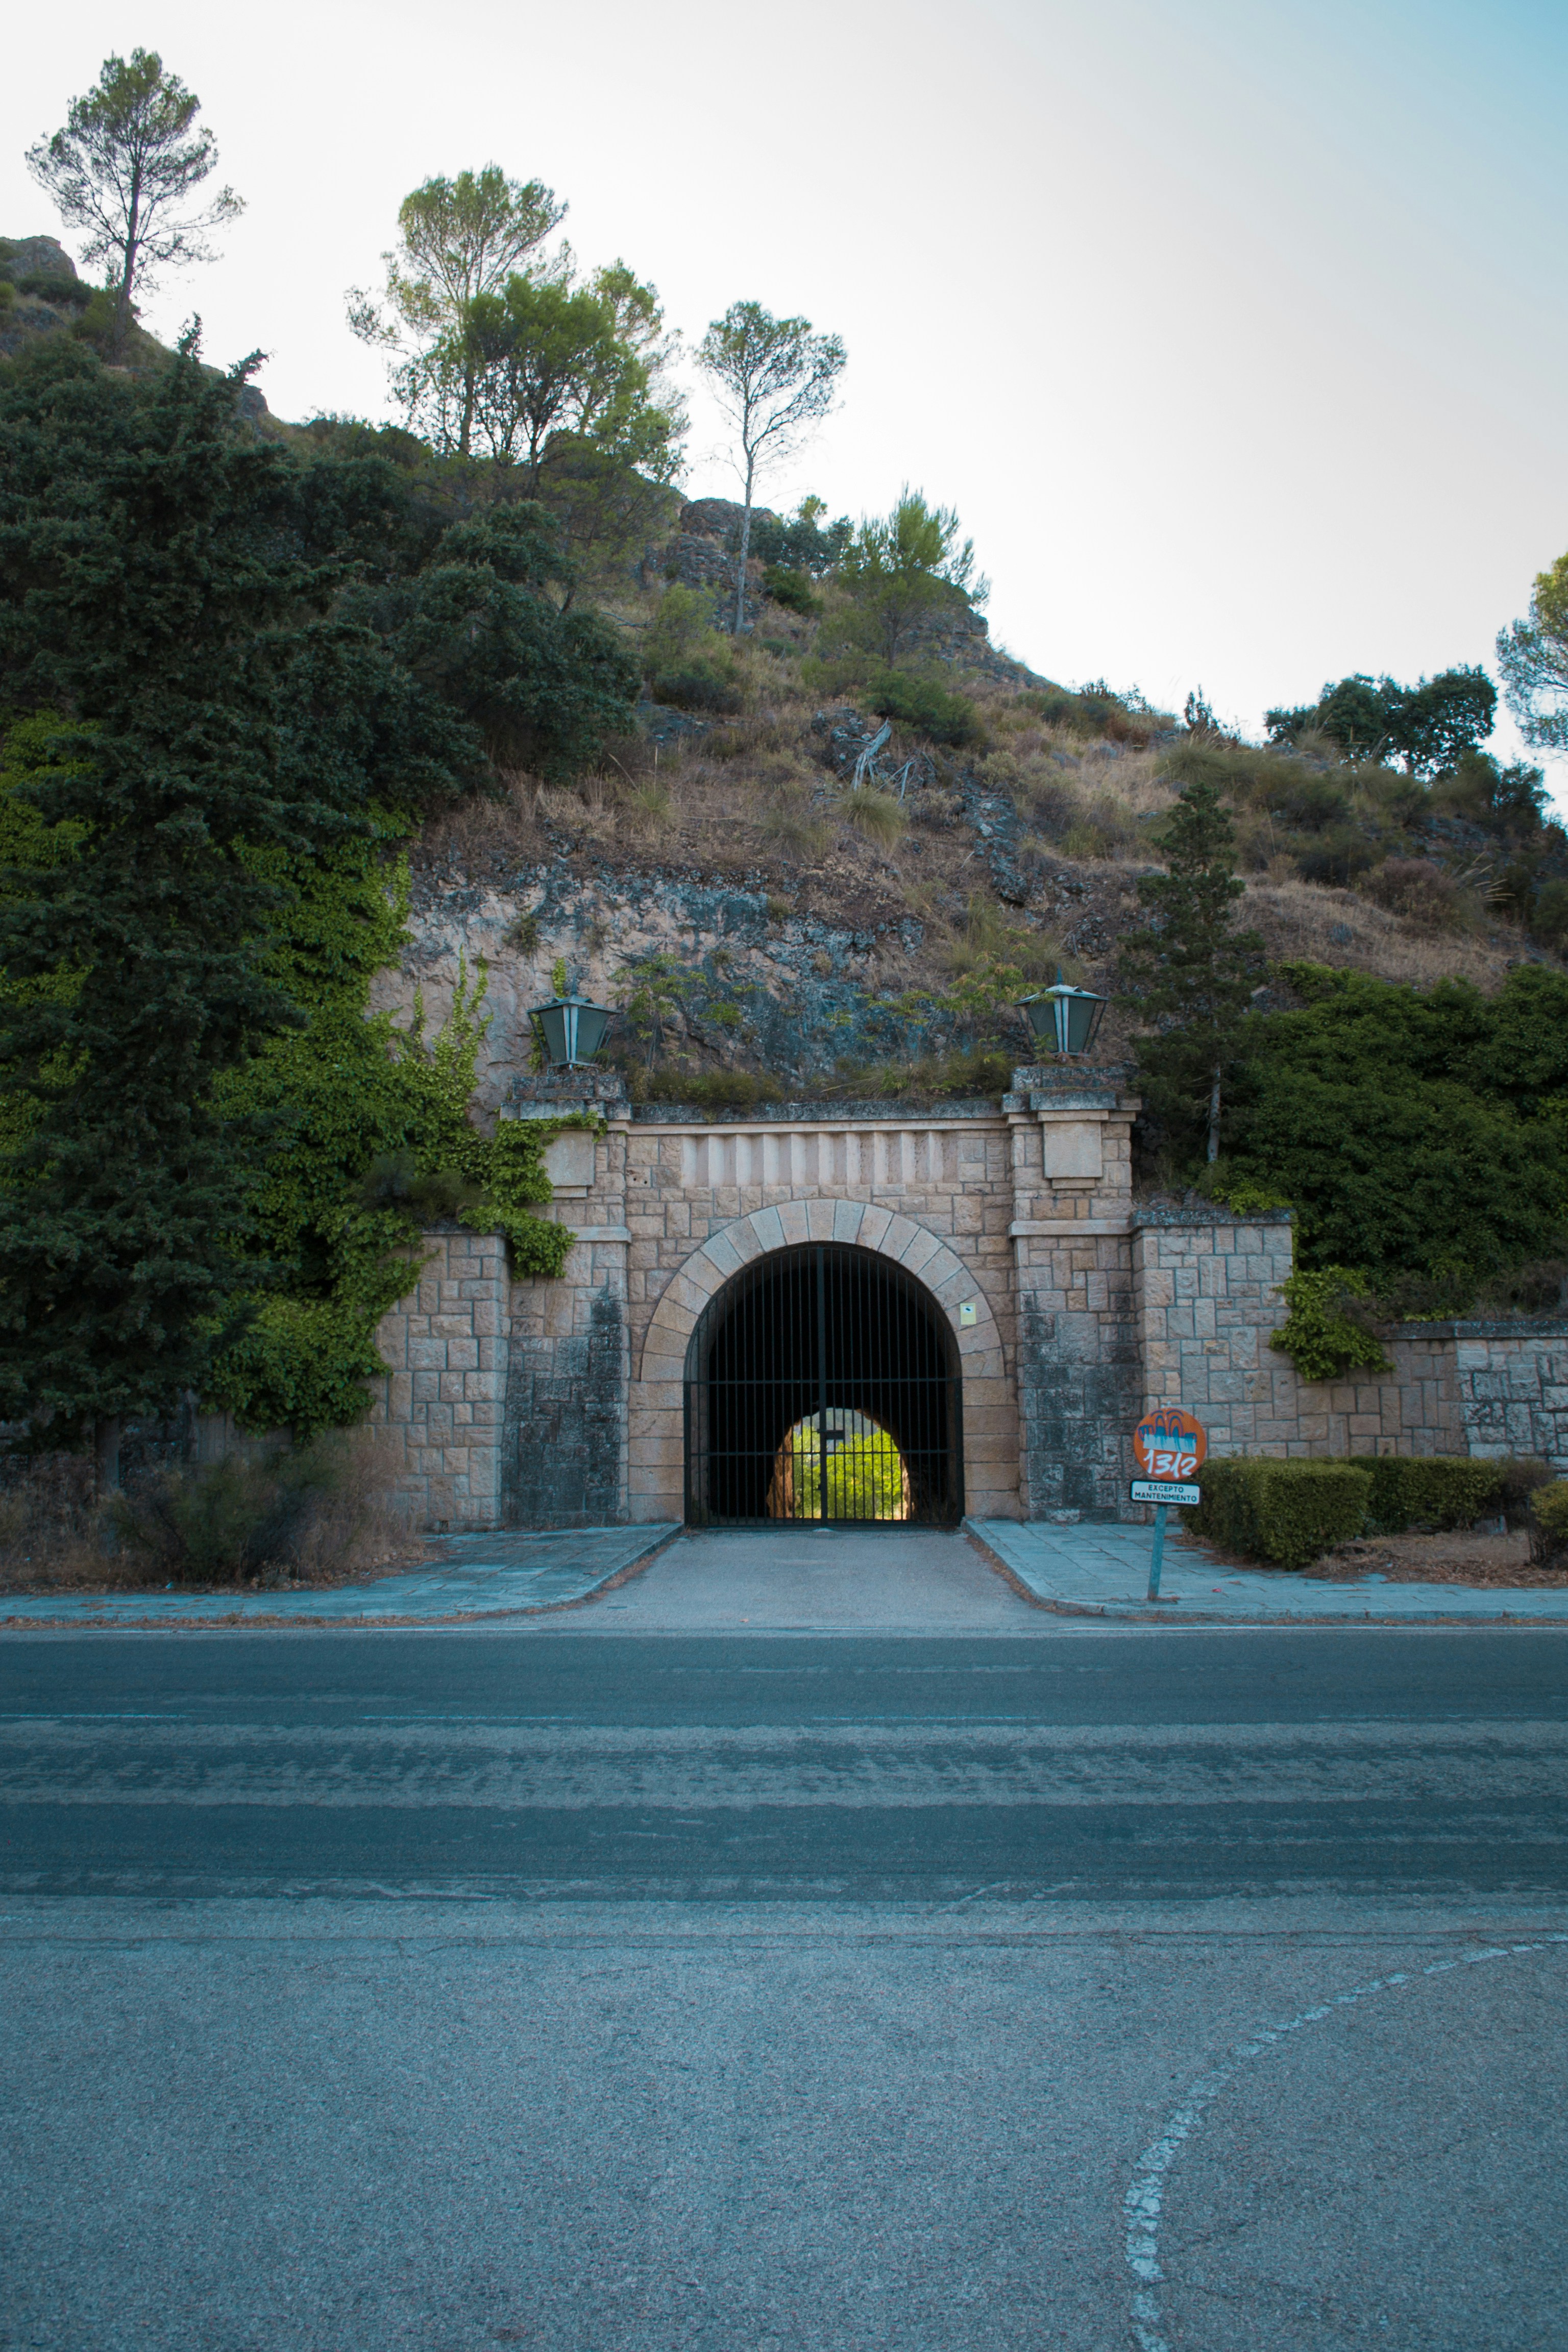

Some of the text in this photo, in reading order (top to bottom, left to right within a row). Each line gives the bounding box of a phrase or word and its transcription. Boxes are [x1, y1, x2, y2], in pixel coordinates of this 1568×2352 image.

[1143, 1449, 1197, 1478] 1312
[1148, 1484, 1184, 1492] EXCEPTO
[1135, 1492, 1197, 1502] MANTENIMIENTO
